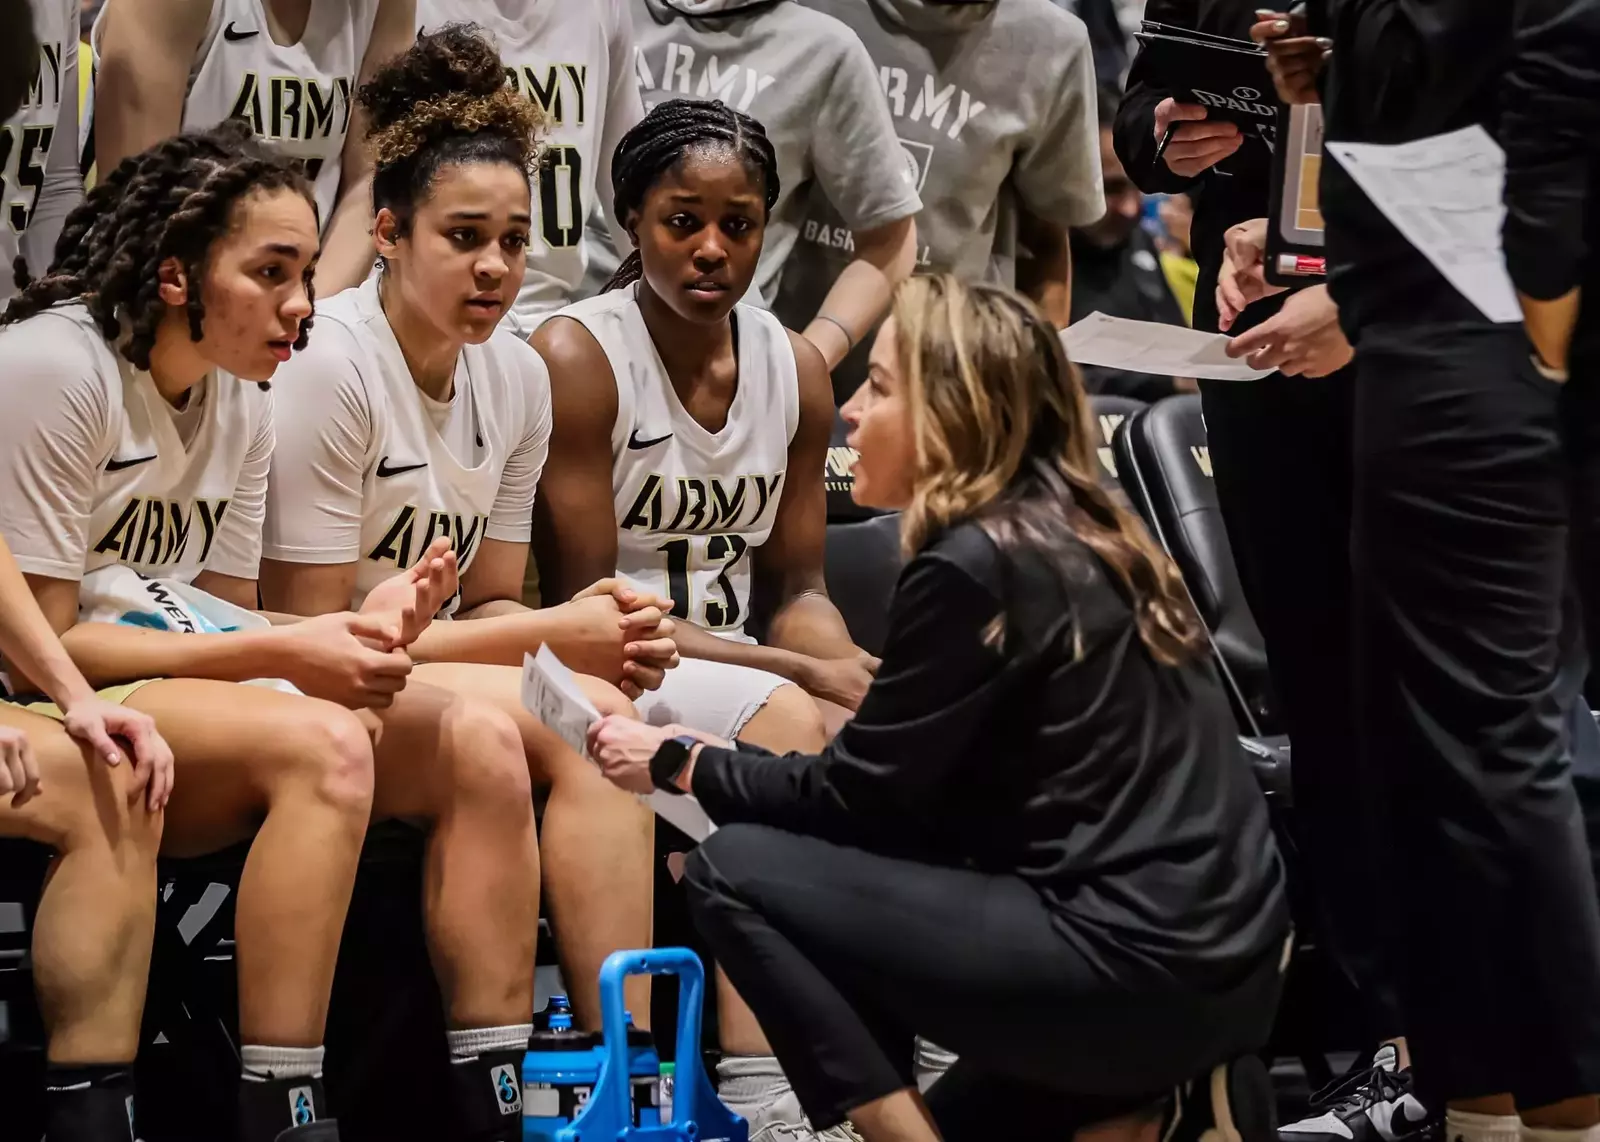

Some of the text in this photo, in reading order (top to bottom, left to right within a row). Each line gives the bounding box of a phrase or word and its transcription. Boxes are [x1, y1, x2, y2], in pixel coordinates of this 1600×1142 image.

[504, 63, 586, 127] MY
[879, 65, 987, 140] RMY
[1190, 88, 1278, 117] SPALD
[91, 496, 230, 566] ARMY
[617, 471, 784, 533] ARMY
[655, 533, 750, 631] 13
